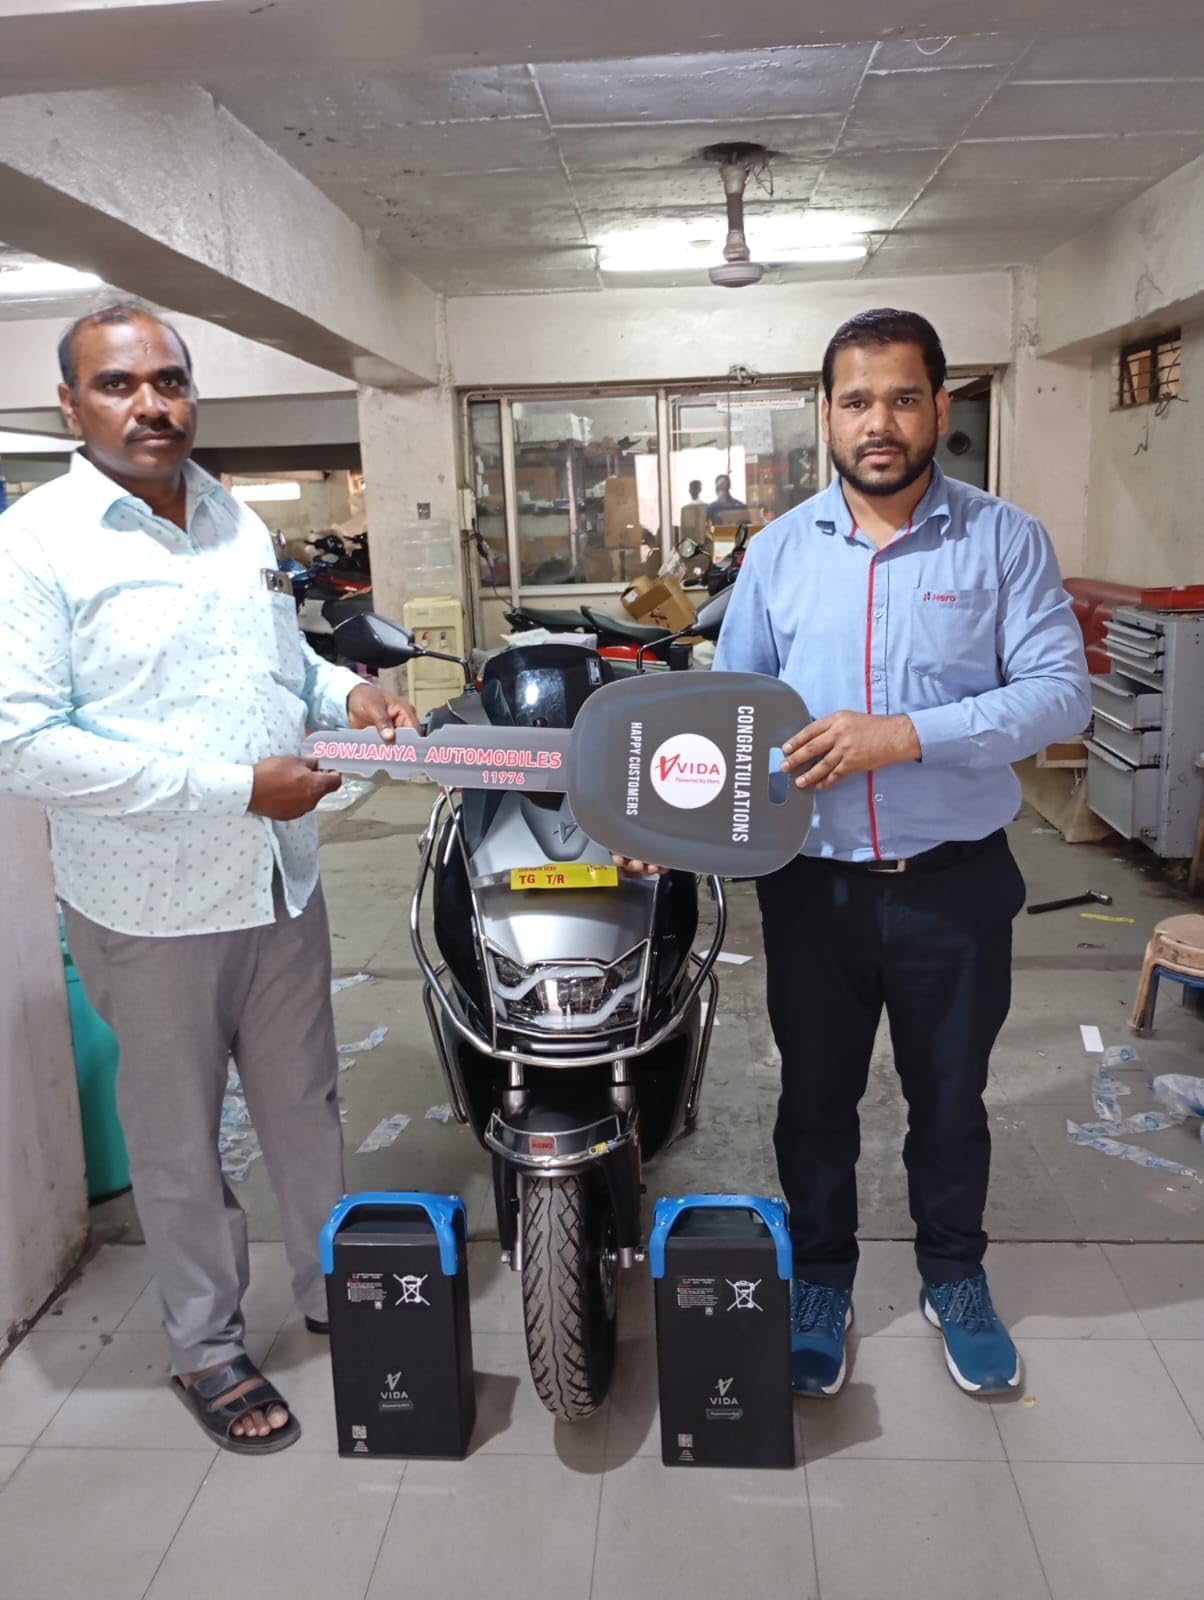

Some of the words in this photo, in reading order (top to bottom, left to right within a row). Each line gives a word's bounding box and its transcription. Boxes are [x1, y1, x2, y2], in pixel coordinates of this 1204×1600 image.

[629, 721, 643, 755] HAPPY
[313, 741, 417, 762] SOWJANYA
[424, 746, 562, 769] AUTOMOBILES
[677, 763, 720, 775] VIDA
[731, 705, 755, 843] CONGRATULATIONS
[482, 770, 525, 784] 11976
[626, 756, 641, 816] CUSTOMERS
[519, 874, 536, 885] TG
[546, 874, 565, 885] T/R
[380, 1391, 409, 1400] VIDA
[709, 1397, 739, 1405] VIDA
